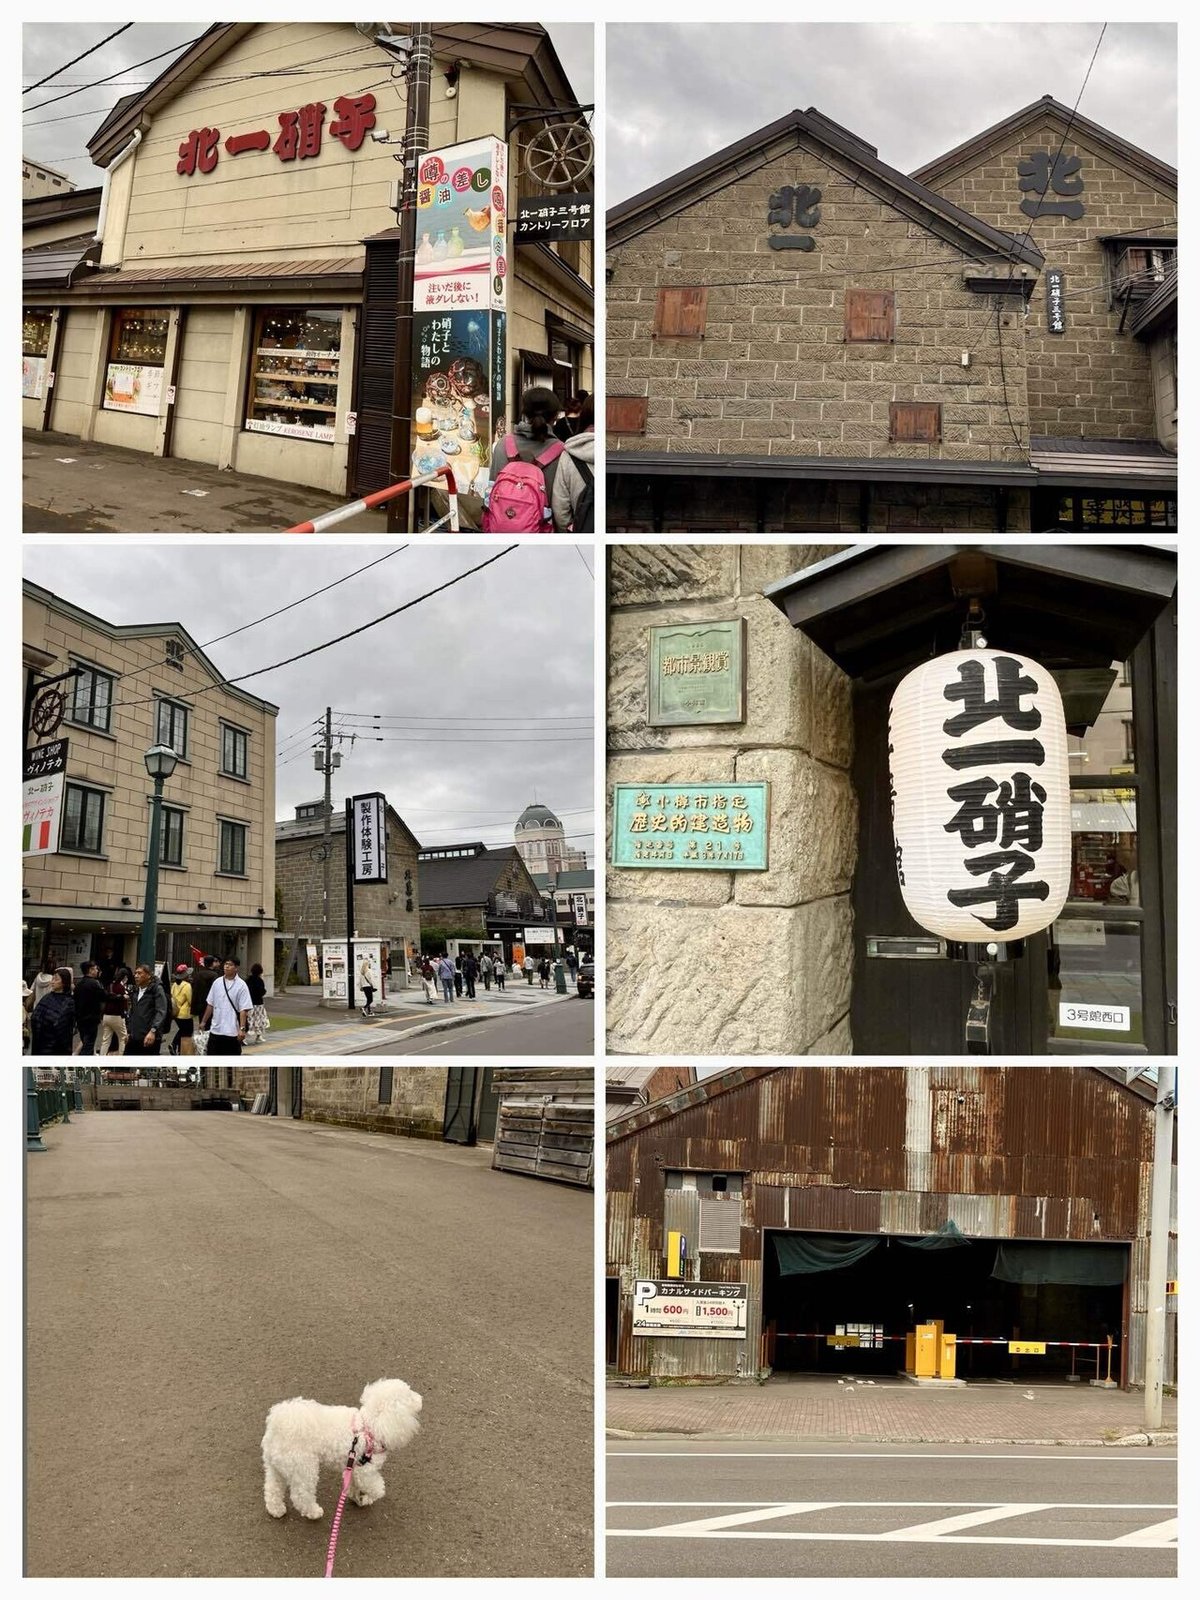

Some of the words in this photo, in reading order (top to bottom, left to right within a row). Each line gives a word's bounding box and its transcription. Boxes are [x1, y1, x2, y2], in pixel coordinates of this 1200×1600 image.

[176, 92, 377, 176] 北一硝子
[1017, 151, 1085, 221] 北一
[520, 203, 591, 219] 北一硝子三号館
[767, 184, 822, 253] 北一
[519, 217, 591, 232] カントリーフロア
[428, 281, 471, 293] 注いだ後に
[431, 319, 442, 366] わたしの
[31, 747, 45, 761] WINE
[46, 742, 62, 758] SHOP
[26, 757, 63, 774] ヴィノテカ
[942, 656, 1050, 931] 北一硝子
[630, 812, 754, 834] 歴史的建造物
[360, 801, 373, 876] 製作体験工房
[1067, 1008, 1124, 1024] 3号館西口
[661, 1287, 740, 1297] カナルサイドパーキング
